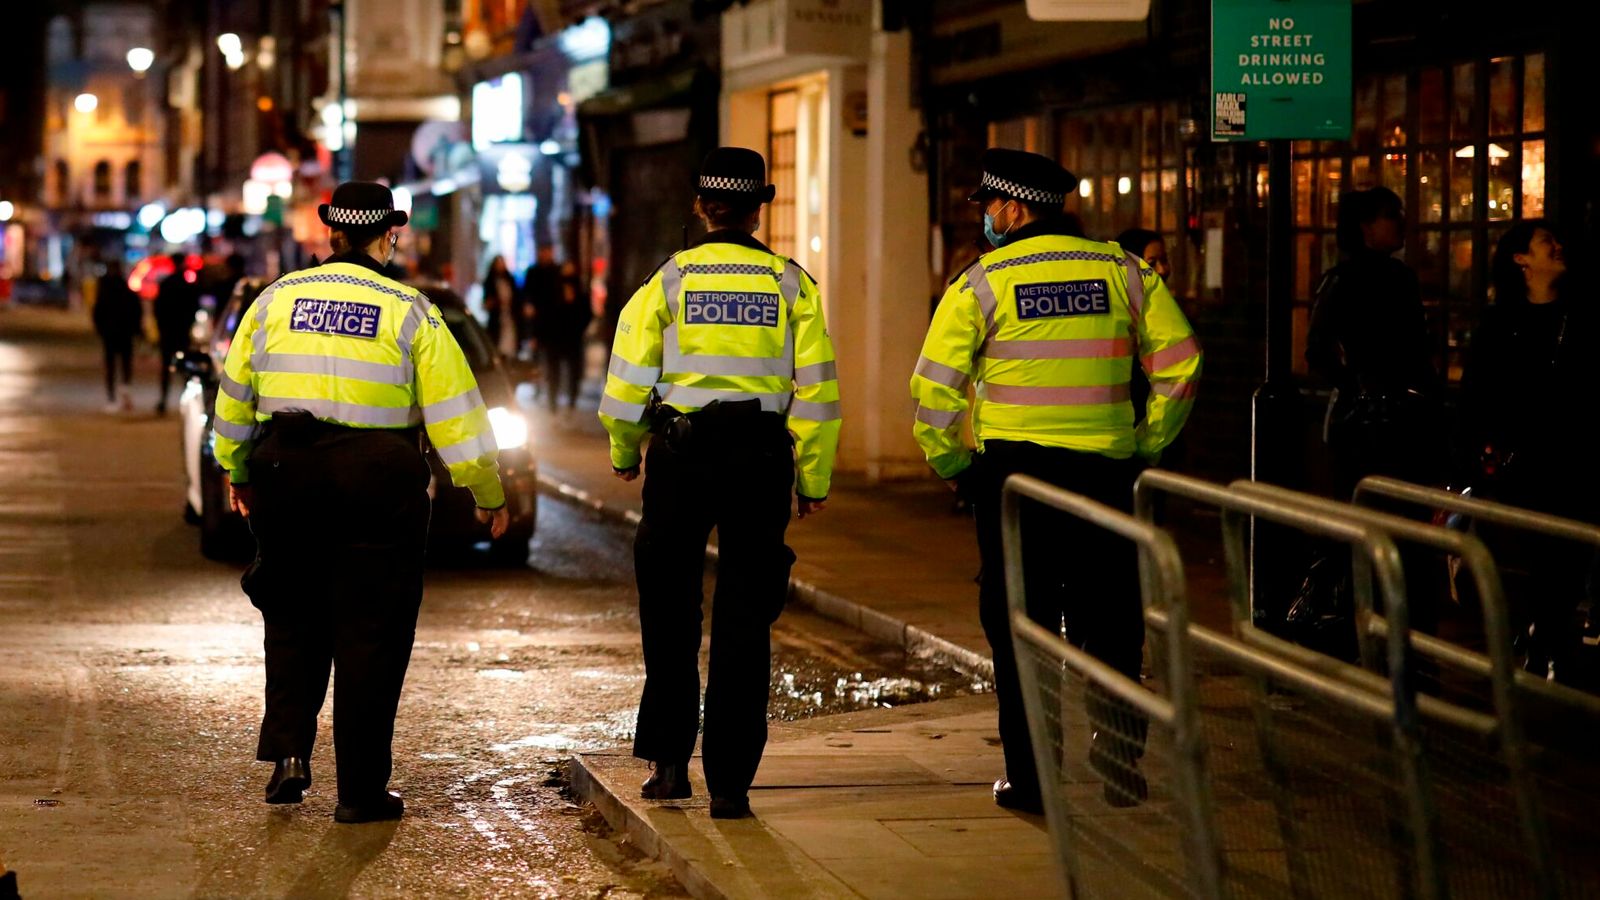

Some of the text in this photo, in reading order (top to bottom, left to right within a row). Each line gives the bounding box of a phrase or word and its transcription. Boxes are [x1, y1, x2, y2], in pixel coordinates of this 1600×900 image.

[1269, 18, 1295, 30] NO
[1251, 35, 1313, 47] STREET
[1238, 54, 1325, 66] DRINKING
[1241, 73, 1324, 85] ALLOWED
[1216, 92, 1237, 102] KARL
[1216, 102, 1239, 110] MARX
[1019, 283, 1104, 296] METROPOLITAN
[686, 293, 778, 305] METROPOLITAN
[1020, 293, 1106, 316] POLICE
[296, 301, 377, 316] METROPOLITAN
[686, 303, 777, 324] POLICE
[293, 310, 375, 334] POLICE
